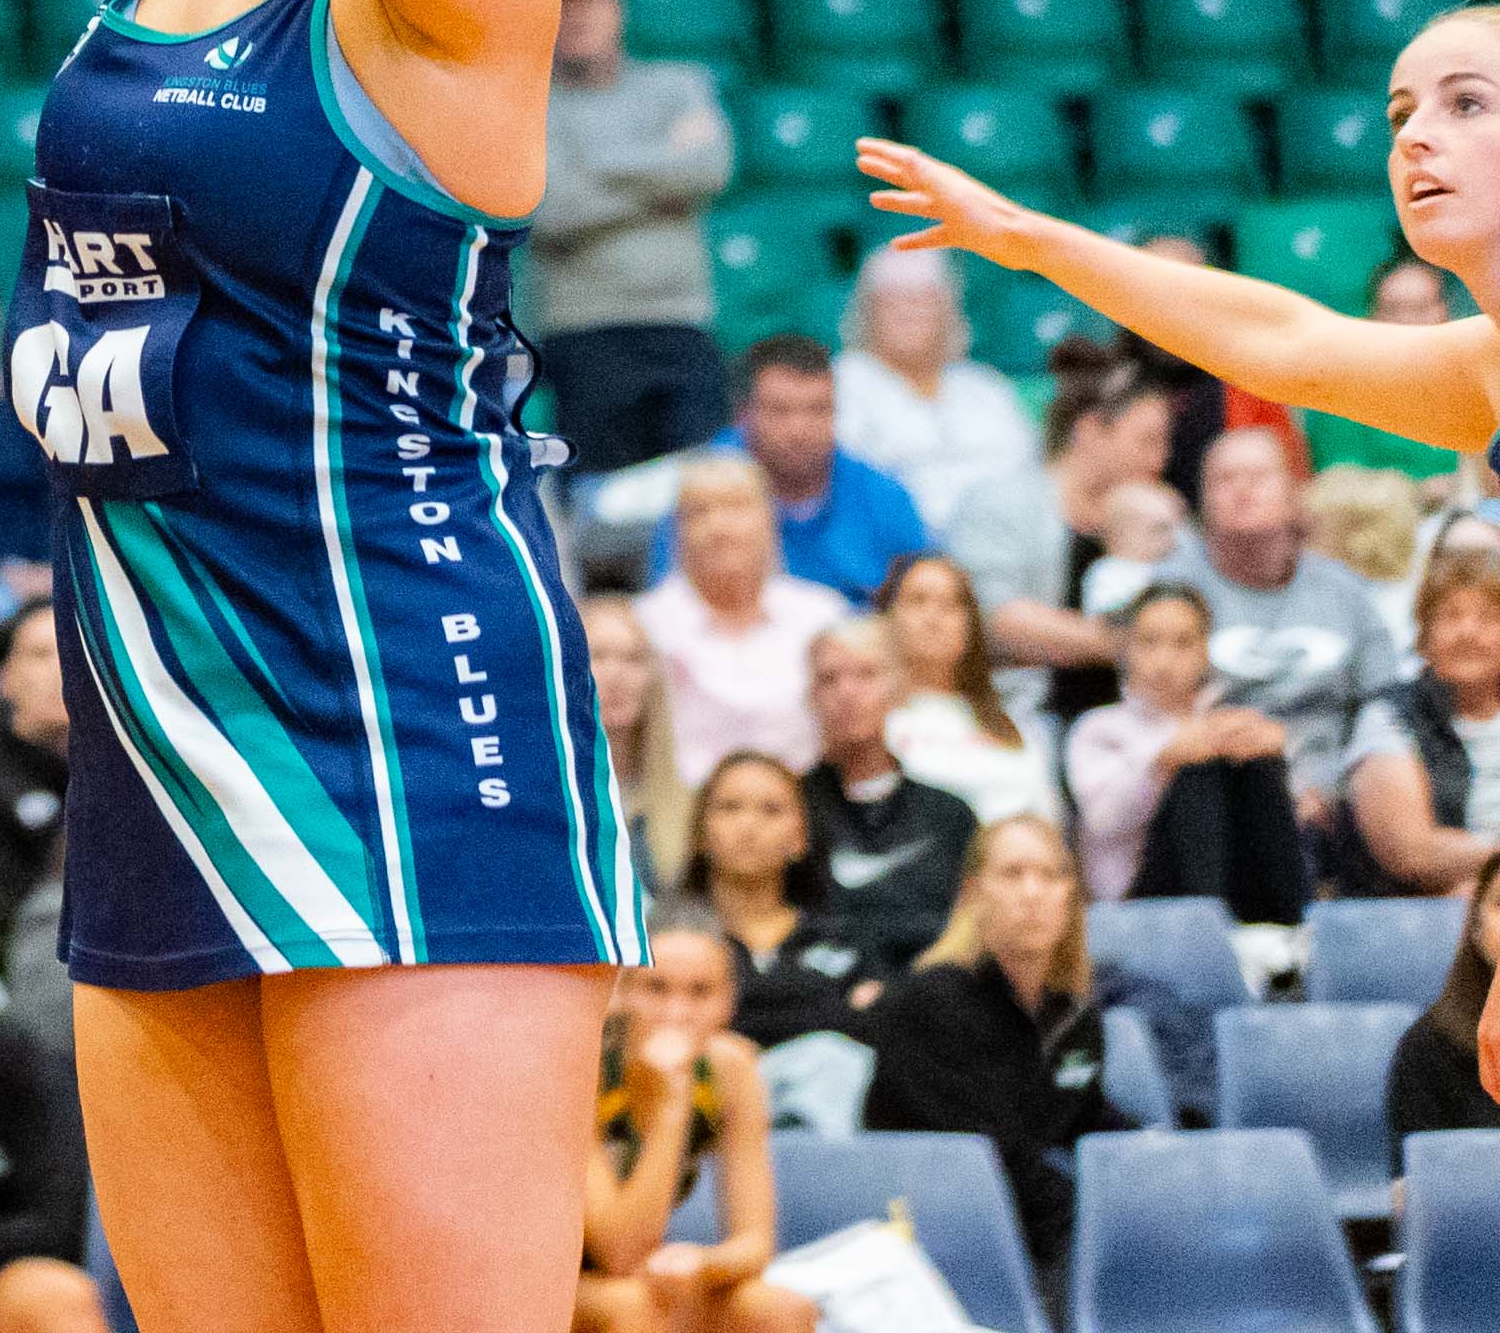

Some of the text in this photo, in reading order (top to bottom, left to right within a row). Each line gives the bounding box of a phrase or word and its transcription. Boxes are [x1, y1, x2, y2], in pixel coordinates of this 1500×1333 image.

[152, 87, 267, 113] NETBALL CLUB
[11, 319, 170, 465] GA
[379, 307, 512, 810] KINGSTON BLUES
